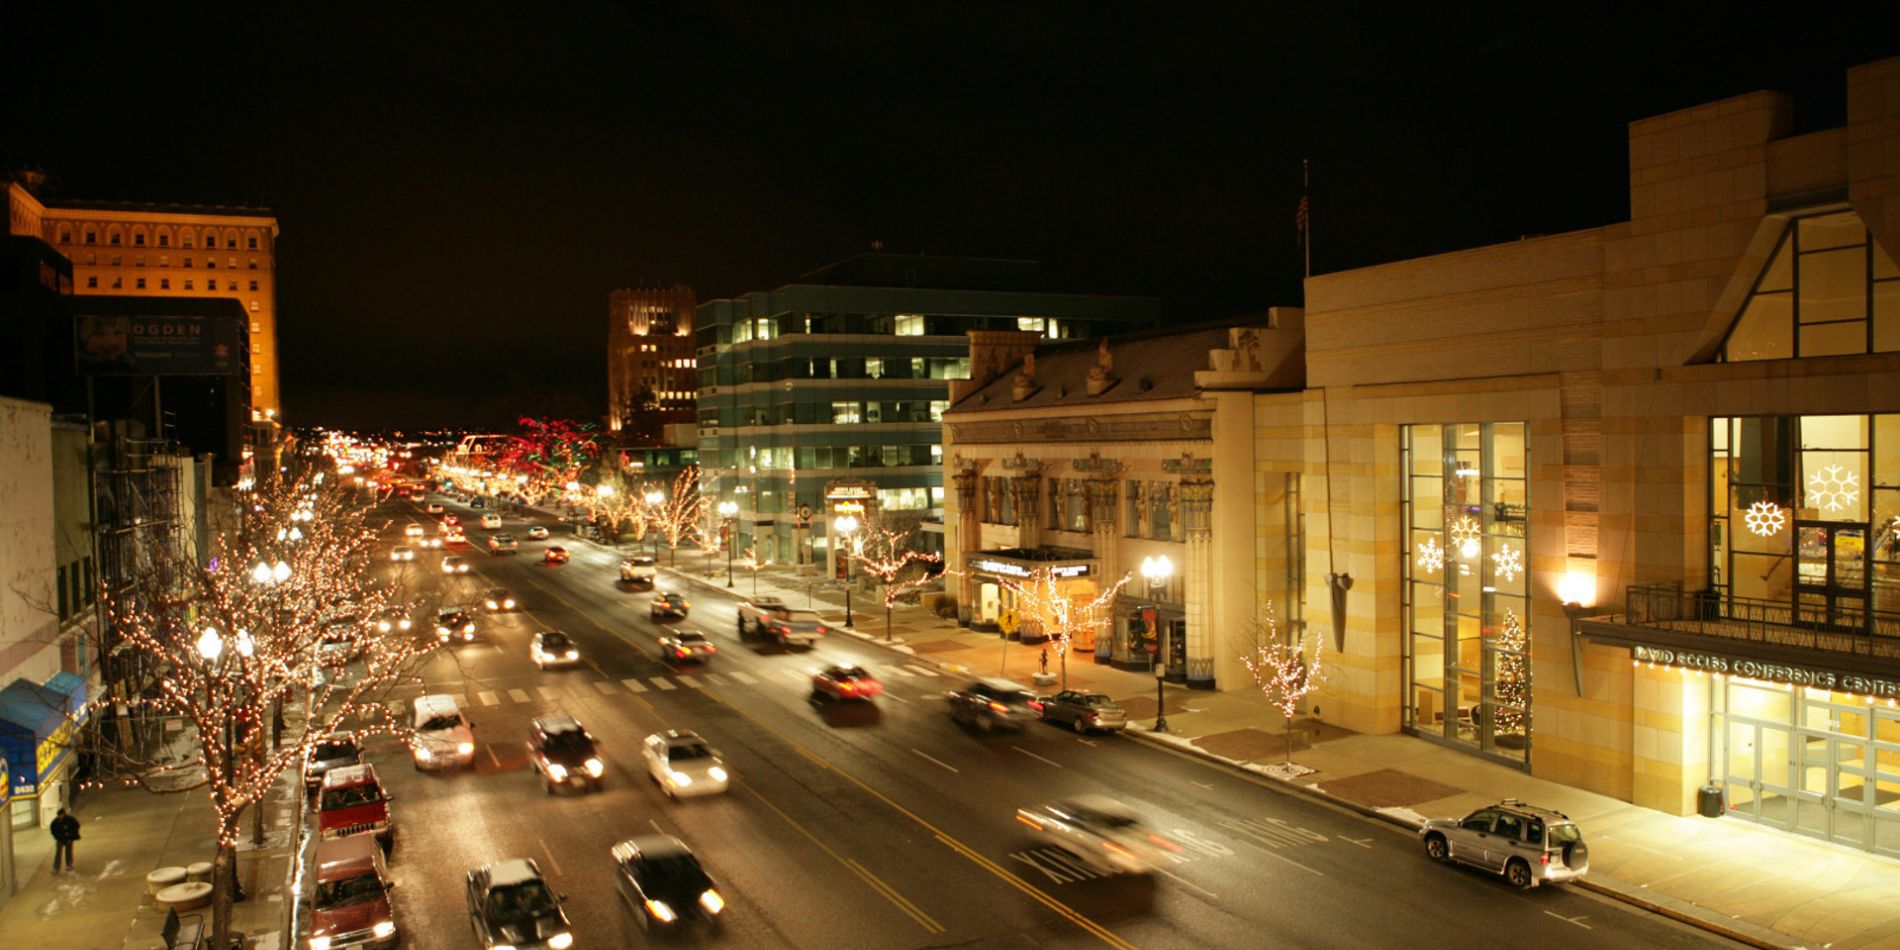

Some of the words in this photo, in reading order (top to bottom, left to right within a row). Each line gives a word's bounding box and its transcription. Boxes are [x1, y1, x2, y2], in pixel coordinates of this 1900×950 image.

[133, 323, 201, 336] OGDEN
[1634, 645, 1674, 664] DAVID
[1677, 652, 1728, 672] ECCLES
[1734, 660, 1836, 687] CONFERENCE
